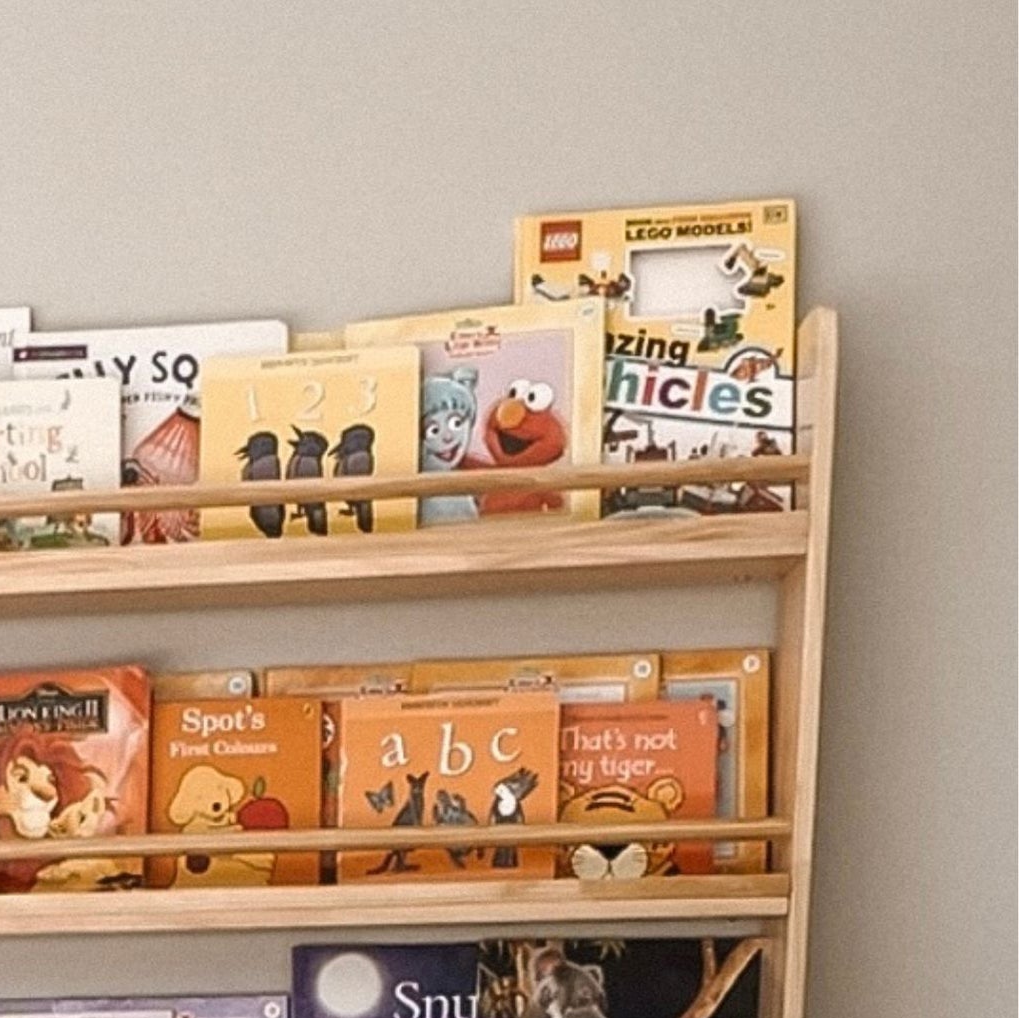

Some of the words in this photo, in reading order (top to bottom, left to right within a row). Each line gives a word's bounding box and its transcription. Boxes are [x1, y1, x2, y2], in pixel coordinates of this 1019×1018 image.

[543, 232, 580, 251] LEGO
[625, 228, 672, 242] LEGO
[676, 221, 753, 237] MODELS!
[247, 385, 262, 421] 1
[297, 379, 326, 420] 2
[347, 374, 377, 416] 3
[608, 358, 774, 420] hicles
[42, 702, 83, 720] KING
[85, 698, 99, 717] II
[181, 704, 266, 734] Spot's
[170, 741, 210, 758] First
[213, 739, 278, 757] Colours
[381, 732, 409, 768] a
[438, 721, 474, 777] b
[490, 726, 521, 763] c
[634, 727, 678, 751] not
